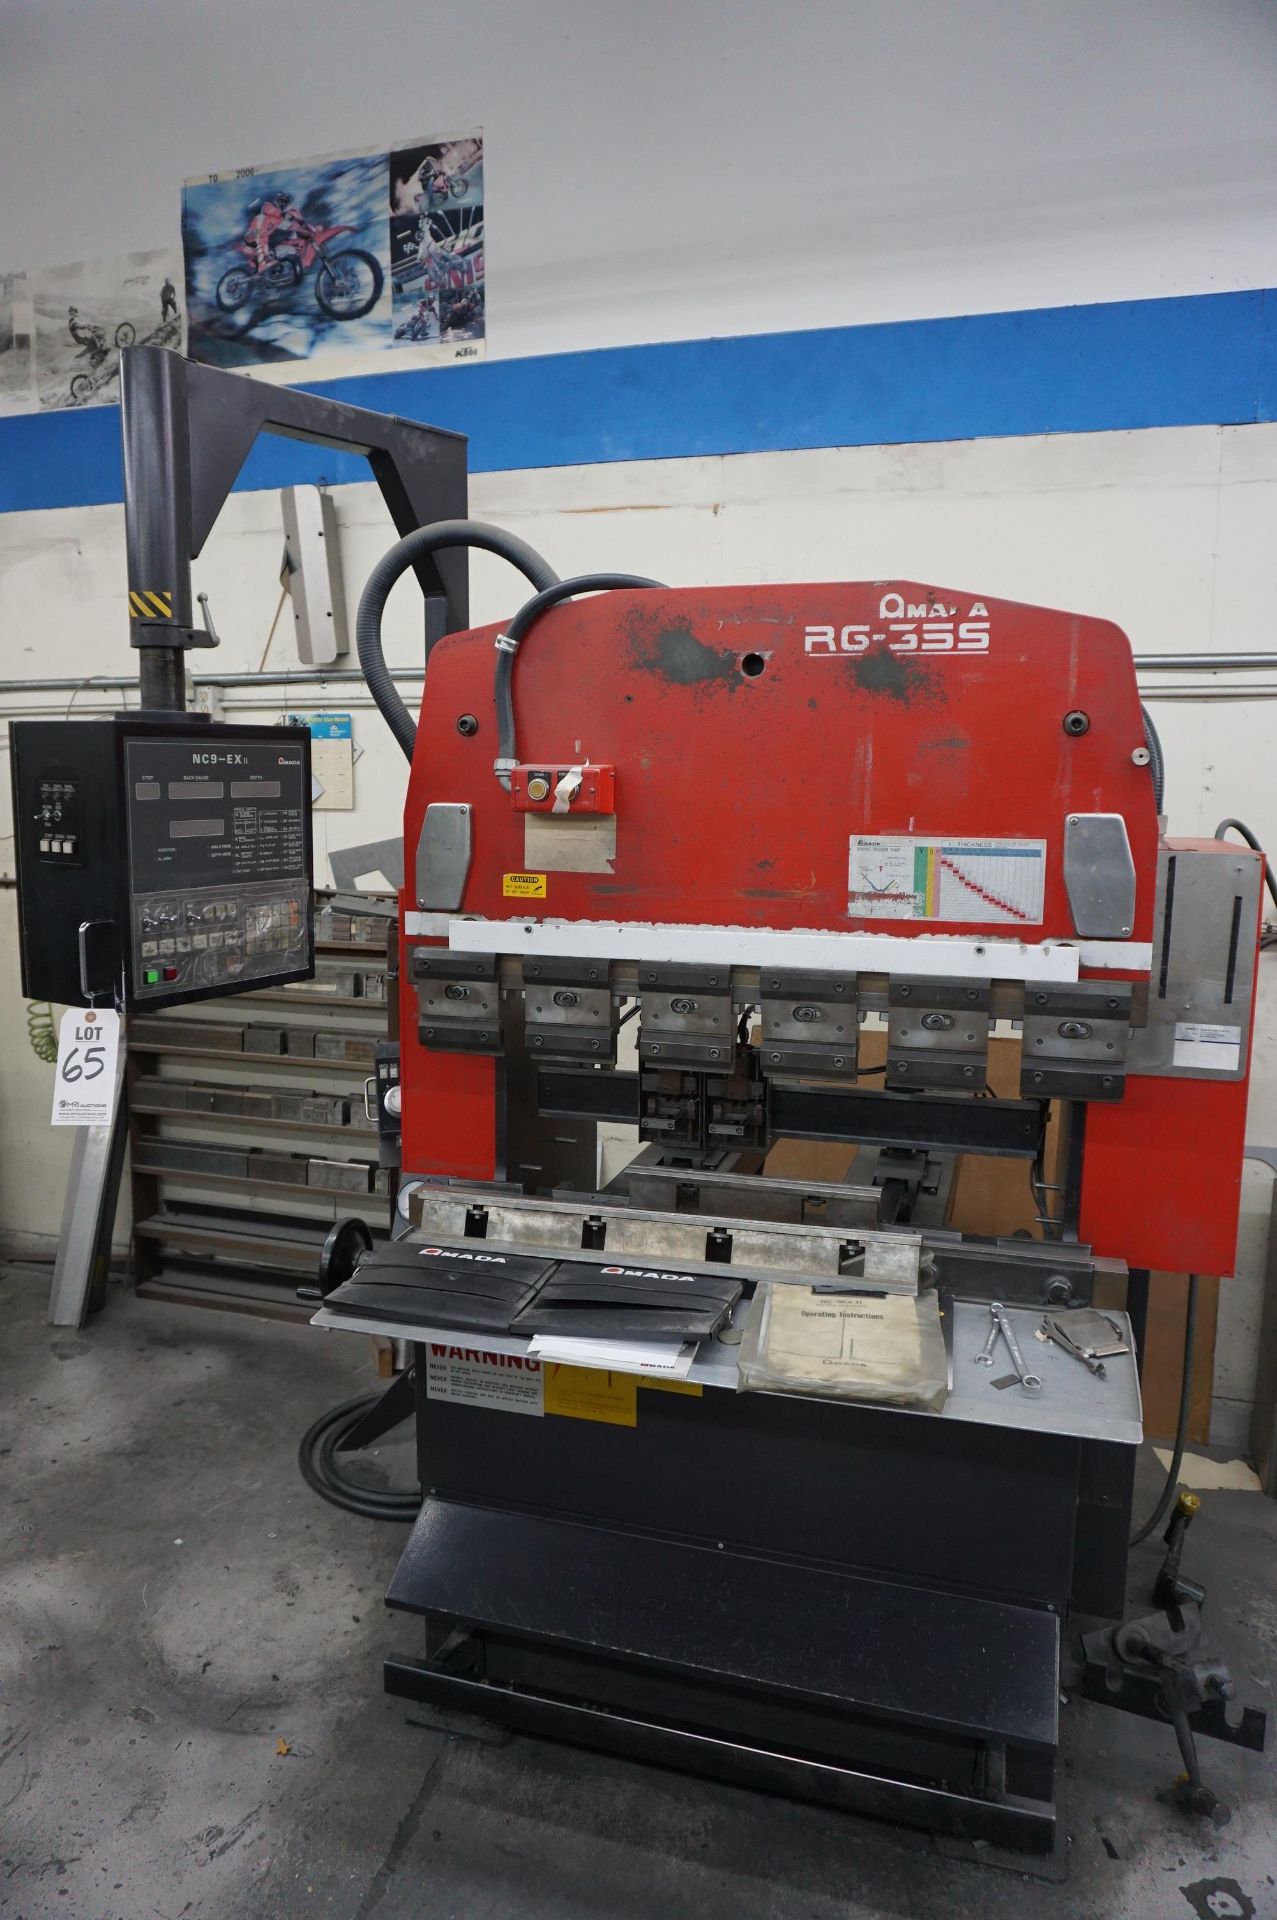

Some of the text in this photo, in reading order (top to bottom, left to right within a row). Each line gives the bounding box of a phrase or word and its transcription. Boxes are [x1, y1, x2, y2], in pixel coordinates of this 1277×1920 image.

[236, 167, 255, 179] 2006
[879, 592, 989, 619] AMAA
[278, 757, 301, 765] AMADA
[75, 1026, 103, 1041] LOT
[62, 1046, 106, 1083] 65
[418, 1247, 508, 1264] AMADA
[600, 1266, 696, 1282] AMADA
[801, 1310, 885, 1320] Operating Instructions
[431, 1343, 541, 1373] WARNING
[429, 1363, 447, 1371] NEVER
[430, 1386, 447, 1394] NEVER
